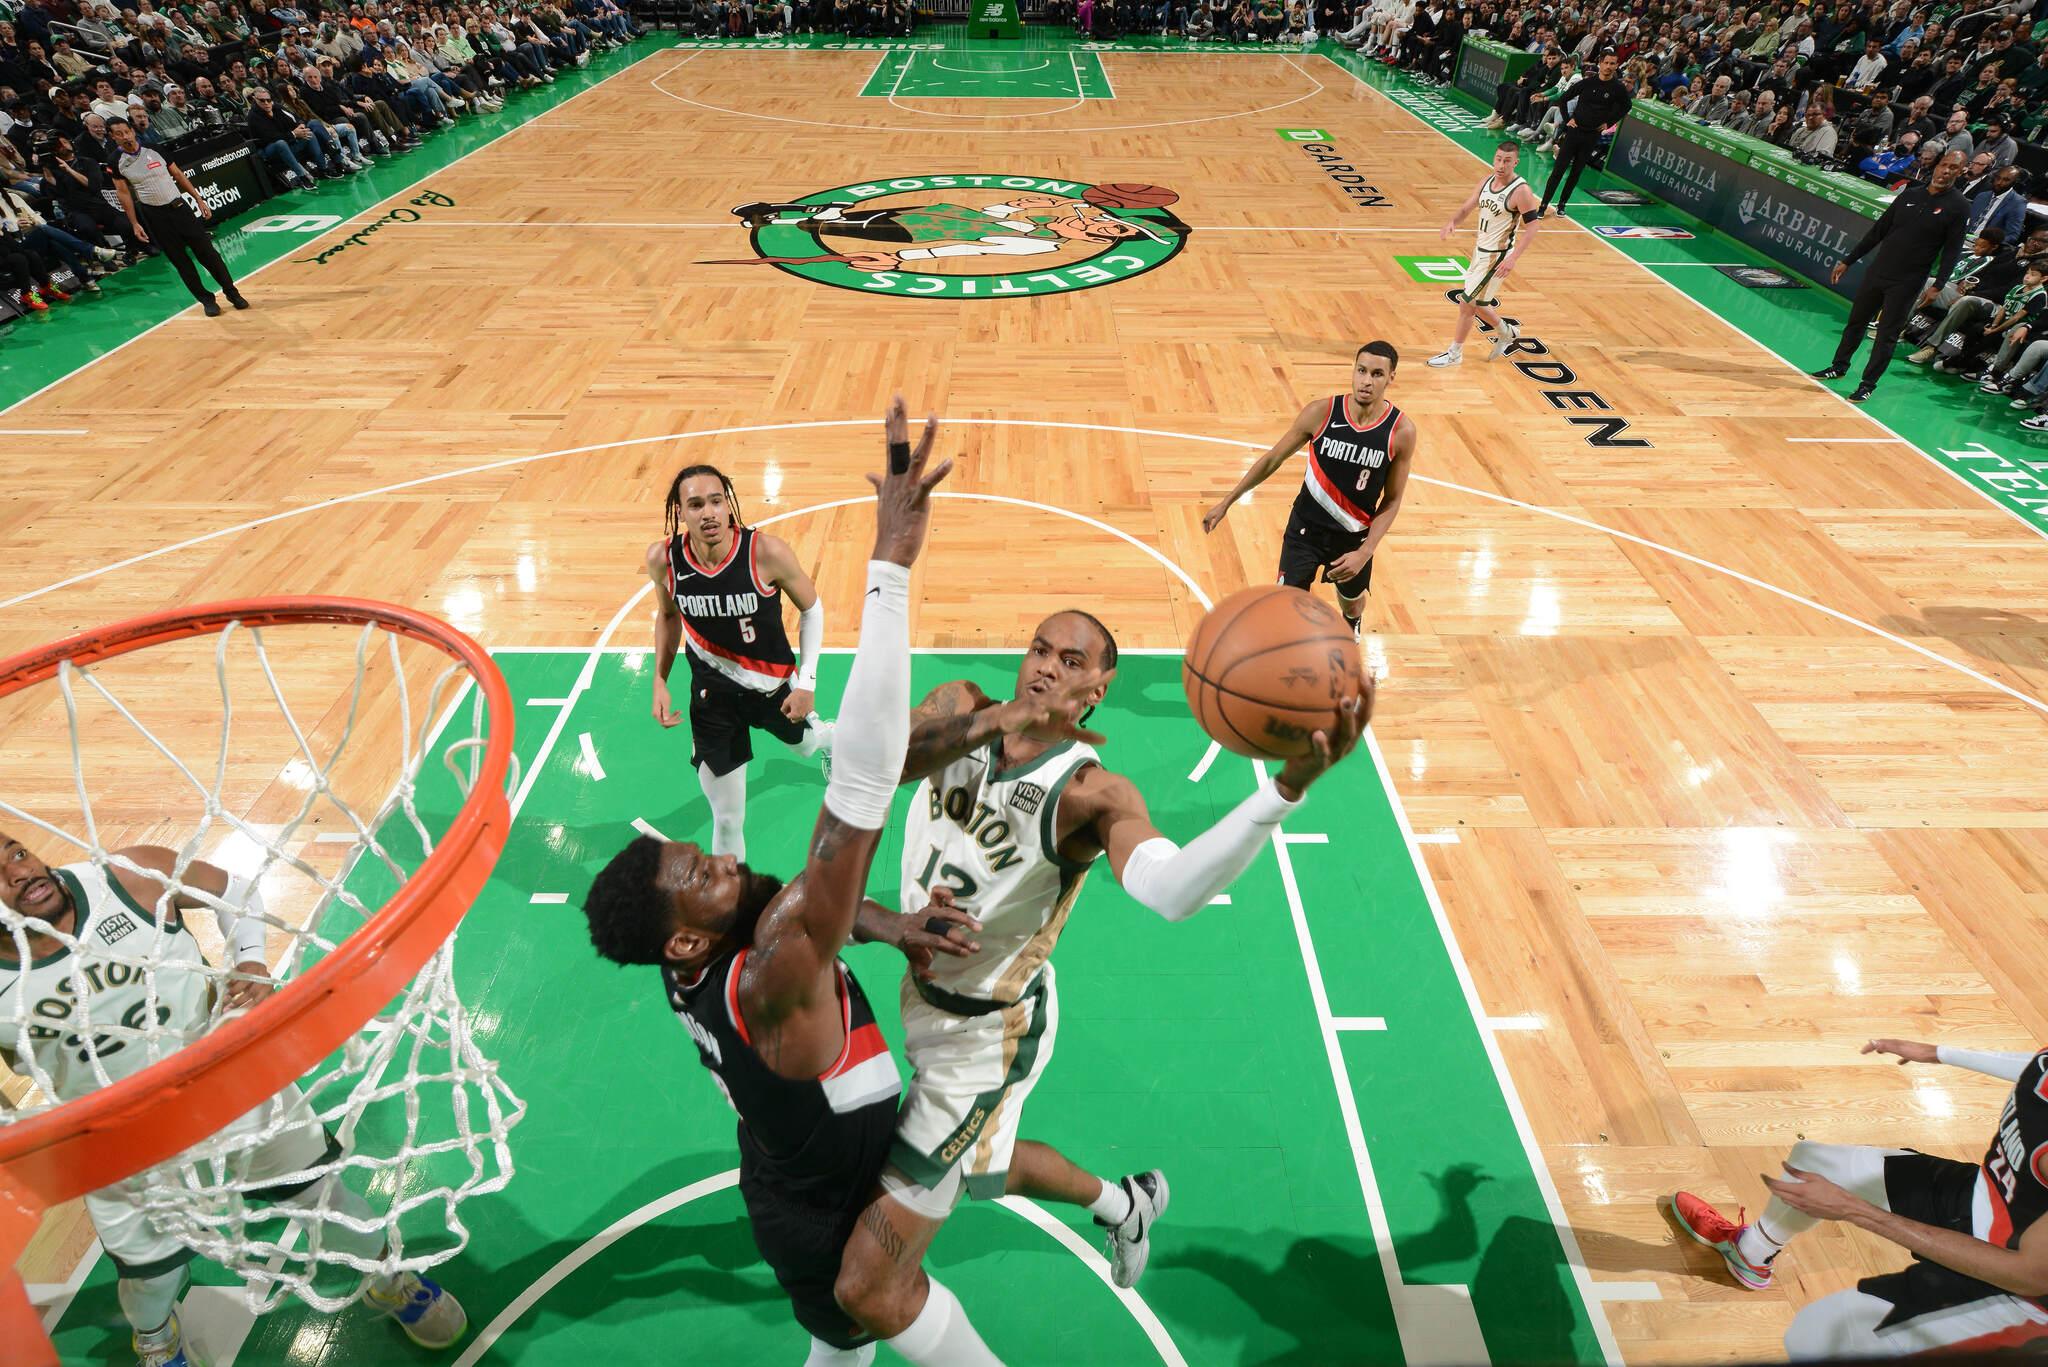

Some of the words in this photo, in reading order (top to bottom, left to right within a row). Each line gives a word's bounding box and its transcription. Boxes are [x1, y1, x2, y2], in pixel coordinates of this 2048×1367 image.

[1385, 89, 1473, 133] TEMPLETON
[201, 146, 251, 173] meetboston.com
[1641, 142, 1718, 192] ARBELLA
[846, 175, 1076, 197] BOSTON
[1301, 143, 1396, 207] GARDEN
[1644, 166, 1702, 202] INSURANCE
[204, 186, 242, 213] OSTON
[1479, 218, 1489, 233] 11
[1760, 222, 1842, 269] INSURANCE
[862, 255, 1145, 294] CELTICS
[1320, 436, 1386, 469] PORTLAND
[1355, 468, 1371, 491] 8
[676, 592, 758, 617] PORTLAND
[739, 617, 756, 643] 5
[1011, 795, 1039, 815] PRINT
[1017, 782, 1044, 804] VISTA
[928, 786, 1025, 874] BOTON
[97, 914, 129, 937] VISTA
[106, 922, 136, 945] PRINT
[940, 1107, 986, 1164] CELTICS
[1989, 1143, 2017, 1205] 24
